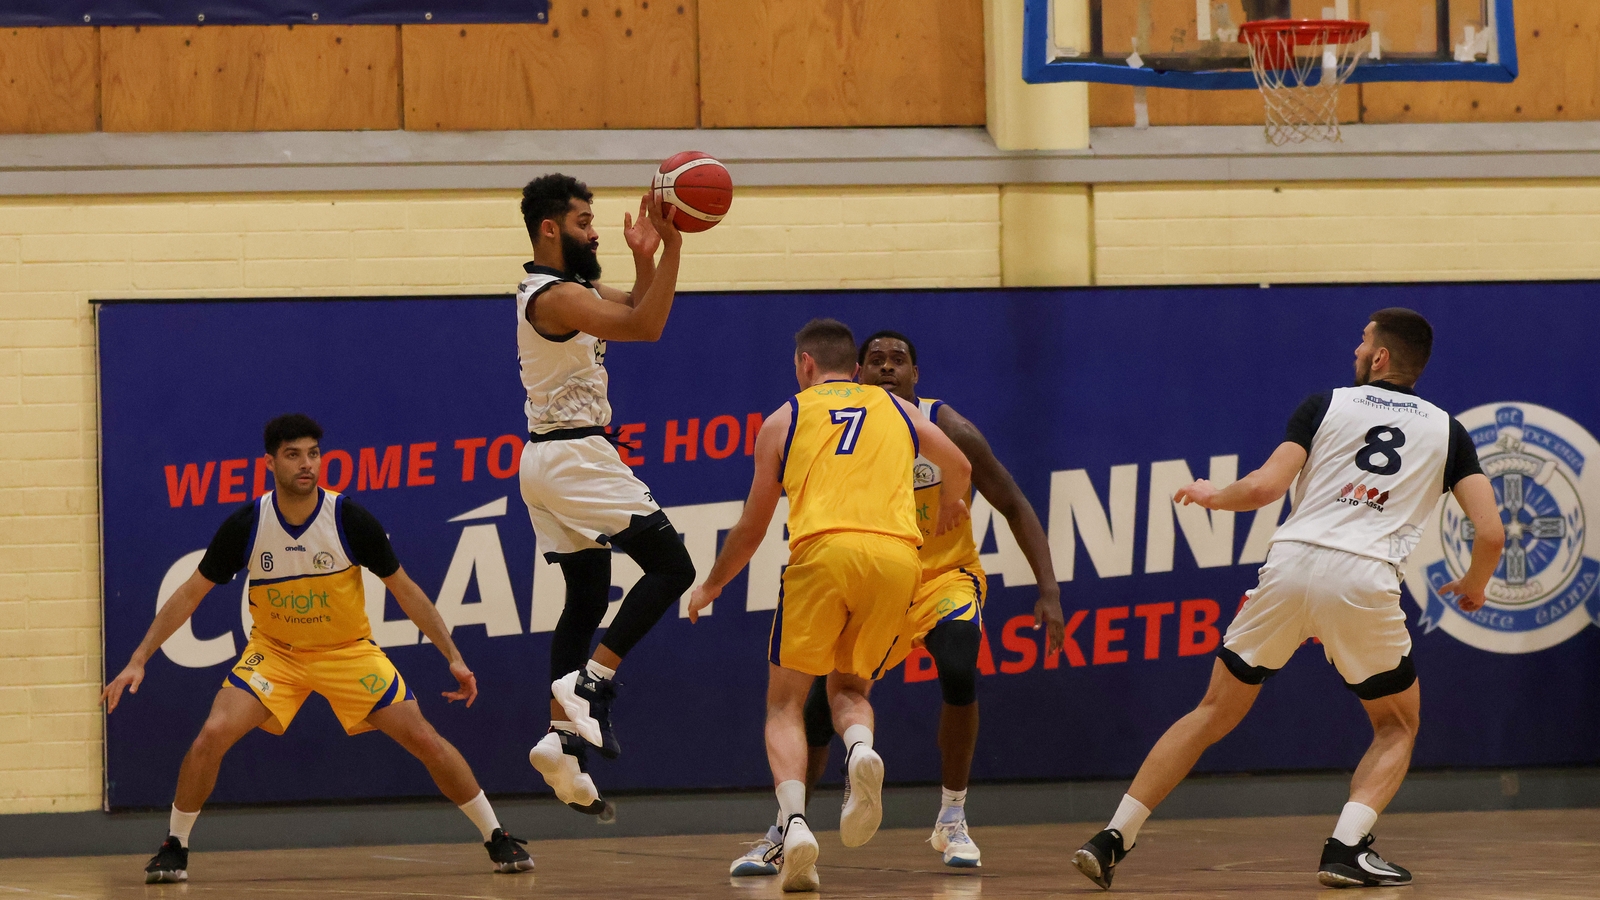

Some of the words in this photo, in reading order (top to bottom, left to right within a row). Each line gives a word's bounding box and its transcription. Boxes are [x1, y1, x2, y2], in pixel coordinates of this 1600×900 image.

[1352, 397, 1390, 411] GRIFFITH
[1392, 407, 1430, 419] COLLEGE
[829, 407, 867, 455] 7
[1355, 425, 1406, 475] 8
[164, 442, 437, 509] WELOME
[454, 434, 525, 482] TO
[1348, 498, 1359, 507] TO
[260, 551, 274, 572] 6
[267, 588, 331, 614] Bright
[270, 611, 281, 620] St
[284, 614, 331, 624] Vincent's
[245, 652, 265, 666] 6
